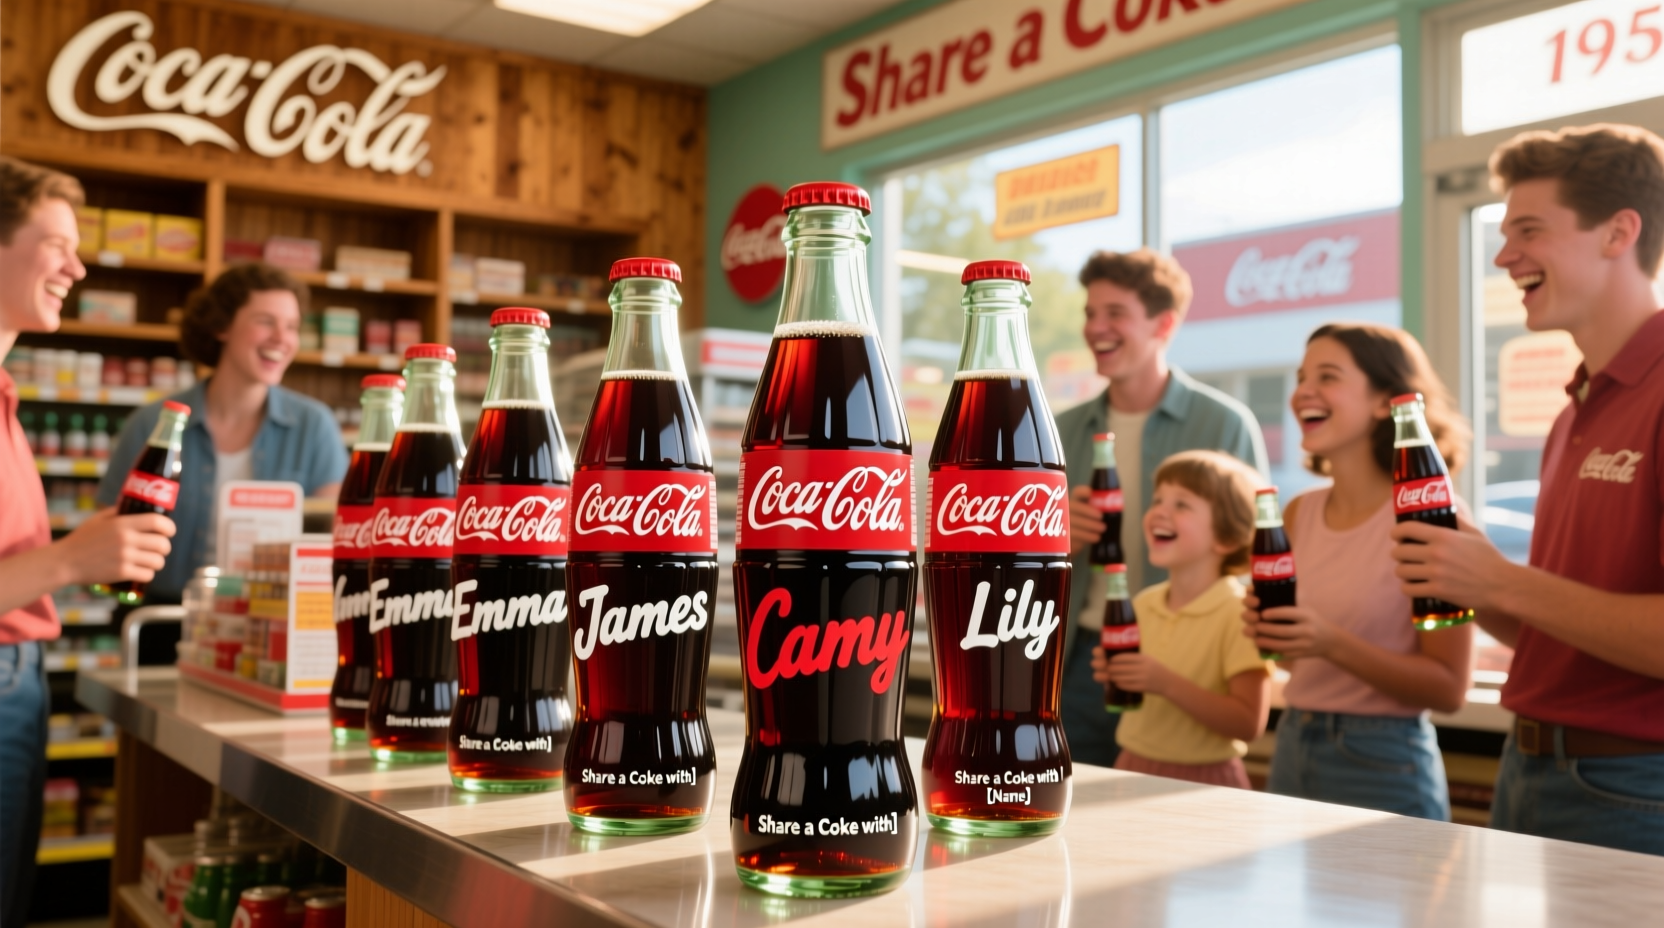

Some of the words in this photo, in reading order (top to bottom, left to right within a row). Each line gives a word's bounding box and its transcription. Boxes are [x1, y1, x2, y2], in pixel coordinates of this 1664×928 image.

[836, 29, 993, 128] Share
[1008, 9, 1043, 70] a
[1063, 0, 1232, 49] Co
[1544, 5, 1663, 84] 195
[47, 10, 447, 176] Coca-Cola
[456, 496, 566, 543] Coca-Cola
[575, 483, 706, 537] Coca-Cola
[748, 465, 908, 532] Coca-Cola
[937, 483, 1067, 537] Coca-Cola
[450, 579, 568, 641] Emma
[573, 584, 708, 661] James
[746, 587, 910, 695] Camy
[960, 579, 1060, 660] Lily
[582, 768, 616, 784] Share
[618, 773, 626, 785] a
[629, 769, 663, 785] Coke
[954, 770, 990, 785] Share
[993, 774, 1001, 785] a
[1004, 770, 1035, 785] Coke
[758, 814, 801, 835] Share
[804, 822, 815, 836] a
[818, 817, 859, 836] Coke
